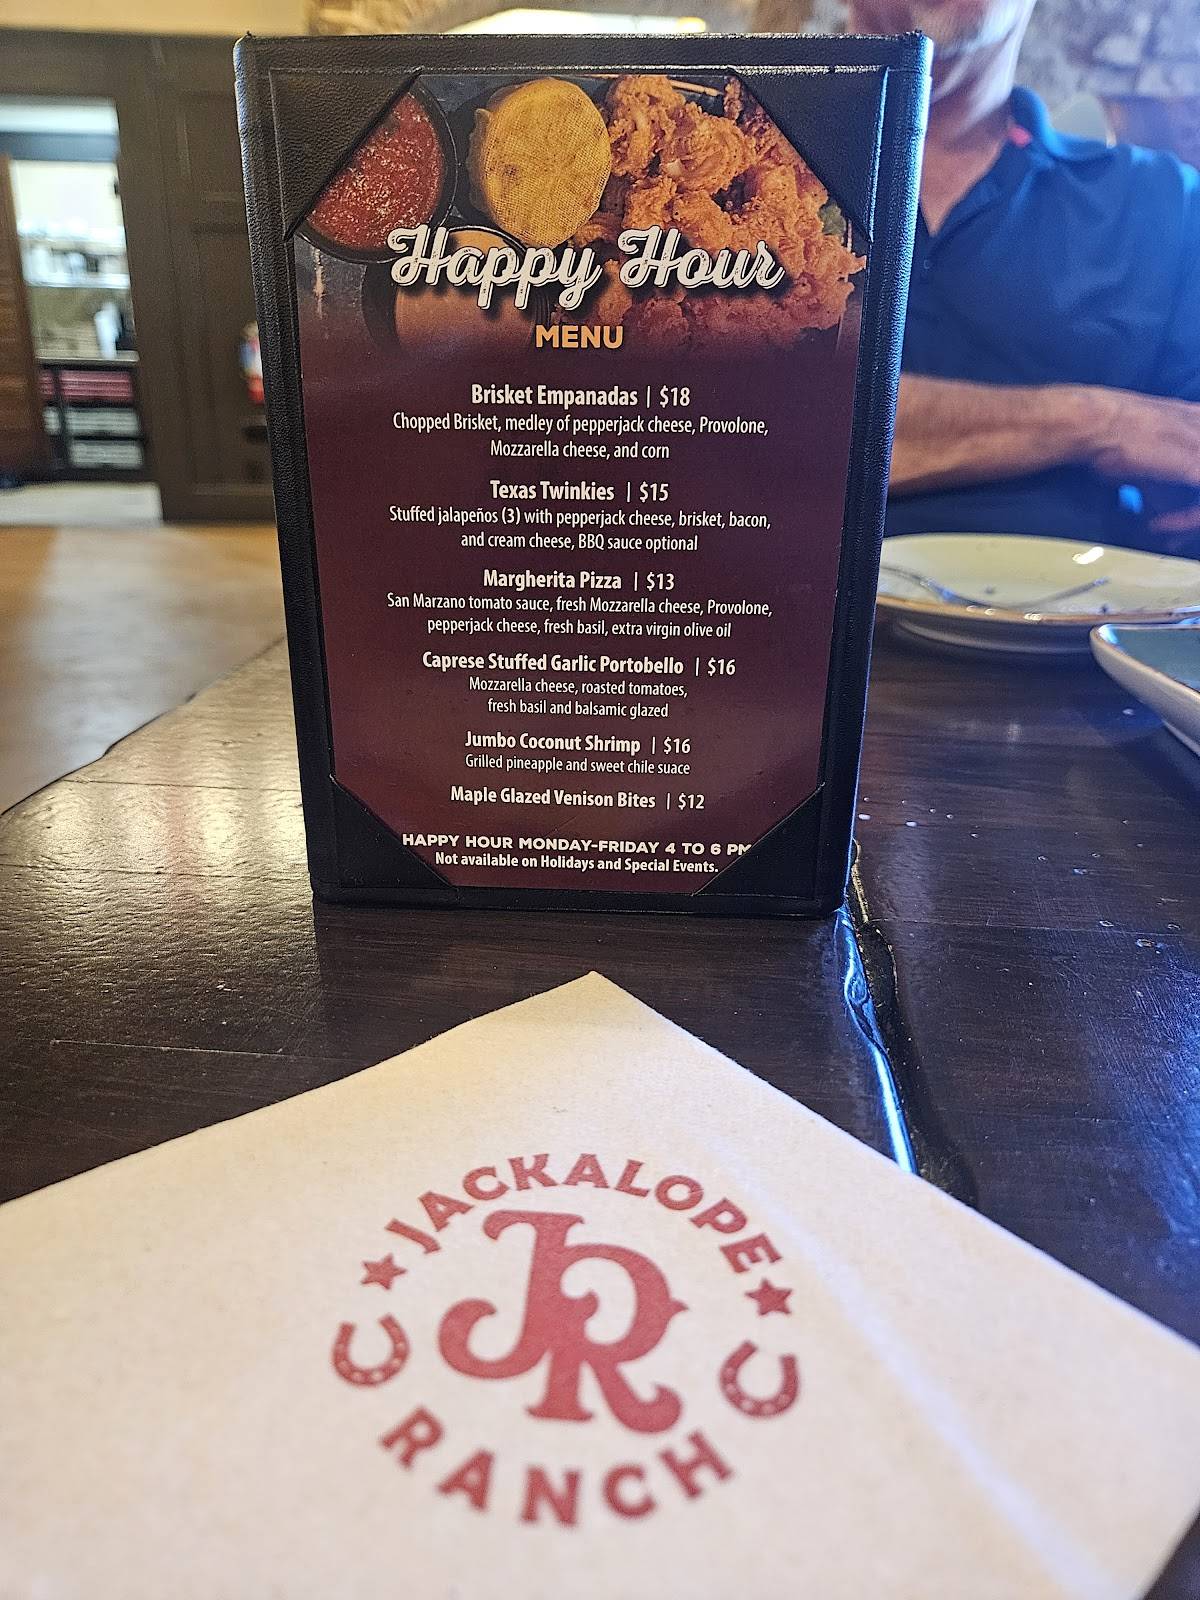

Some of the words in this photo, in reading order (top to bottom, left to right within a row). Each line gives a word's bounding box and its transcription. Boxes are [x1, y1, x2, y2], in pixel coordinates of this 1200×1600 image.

[387, 225, 602, 310] Happy
[617, 225, 785, 289] Hour
[535, 325, 624, 349] MENU
[472, 384, 533, 404] Brisket
[538, 385, 637, 409] Empanadas
[660, 385, 690, 408] $18
[394, 412, 450, 433] Chopped
[454, 413, 501, 432] Brisket,
[506, 414, 553, 435] medley
[557, 415, 570, 431] of
[573, 416, 644, 435] pepperjack
[648, 416, 695, 435] cheese,
[700, 416, 768, 435] Provolone,
[491, 440, 559, 456] Mozzarella
[563, 441, 610, 460] cheese,
[614, 442, 638, 457] and
[642, 446, 669, 458] corn
[490, 480, 536, 499] Texas
[540, 481, 614, 500] Twinkies
[640, 481, 668, 502] $15
[390, 506, 434, 521] Stuffed
[438, 507, 498, 526] jalapeños
[502, 507, 520, 524] (3)
[524, 509, 552, 523] with
[557, 510, 625, 528] pepperjack
[629, 510, 675, 528] cheese,
[679, 511, 725, 528] brisket,
[729, 511, 770, 529] bacon,
[461, 532, 484, 546] and
[488, 536, 525, 547] cream
[529, 533, 574, 550] cheese,
[579, 534, 604, 550] BBQ
[608, 538, 642, 549] sauce
[646, 535, 697, 553] optional
[484, 569, 575, 591] Margherita
[580, 571, 621, 589] Pizza
[647, 572, 674, 591] $13
[387, 592, 409, 607] San
[414, 593, 465, 608] Marzano
[469, 596, 512, 609] tomato
[516, 599, 553, 612] sauce,
[556, 596, 586, 611] fresh
[590, 597, 655, 612] Mozzarella
[659, 598, 703, 615] cheese,
[708, 600, 772, 617] Provolone,
[428, 618, 493, 634] pepperjack
[497, 618, 540, 635] cheese,
[544, 619, 573, 633] fresh
[577, 620, 608, 636] basil,
[612, 623, 642, 635] extra
[646, 622, 680, 639] virgin
[684, 622, 713, 636] olive
[716, 623, 731, 637] oil
[423, 652, 484, 671] Caprese
[488, 653, 546, 670] Stuffed
[551, 655, 596, 671] Garlic
[600, 656, 683, 674] Portobello
[708, 657, 735, 676] $16
[470, 677, 531, 691] Mozzarella
[535, 678, 578, 695] cheese,
[582, 681, 625, 694] roasted
[629, 682, 687, 698] tomatoes,
[488, 698, 516, 712] fresh
[520, 699, 546, 713] basil
[550, 701, 571, 714] and
[575, 701, 626, 716] balsamic
[630, 703, 668, 719] glazed
[465, 731, 516, 747] Jumbo
[520, 733, 581, 750] Coconut
[585, 735, 640, 756] Shrimp
[664, 737, 690, 754] $16
[466, 754, 502, 768] Grilled
[507, 756, 563, 773] pineapple
[566, 758, 587, 771] and
[591, 761, 624, 772] sweet
[628, 760, 654, 773] chile
[658, 764, 690, 774] suace
[451, 786, 497, 805] Maple
[501, 788, 550, 804] Glazed
[554, 790, 613, 806] Venison
[618, 792, 655, 807] Bites
[679, 793, 704, 810] $12
[403, 834, 459, 846] HAPPY
[466, 836, 513, 848] HOUR
[519, 838, 659, 853] MONDAY-FRIDAY
[665, 843, 675, 854] 4
[682, 843, 704, 854] TO
[711, 844, 721, 855] 6
[436, 852, 458, 864] Not
[461, 853, 518, 866] available
[522, 858, 537, 867] on
[541, 855, 594, 871] Holidays
[597, 858, 621, 870] and
[625, 858, 669, 873] Special
[673, 860, 718, 872] Events.
[384, 1153, 783, 1274] JACKALOPE
[379, 1405, 734, 1528] RANCH
